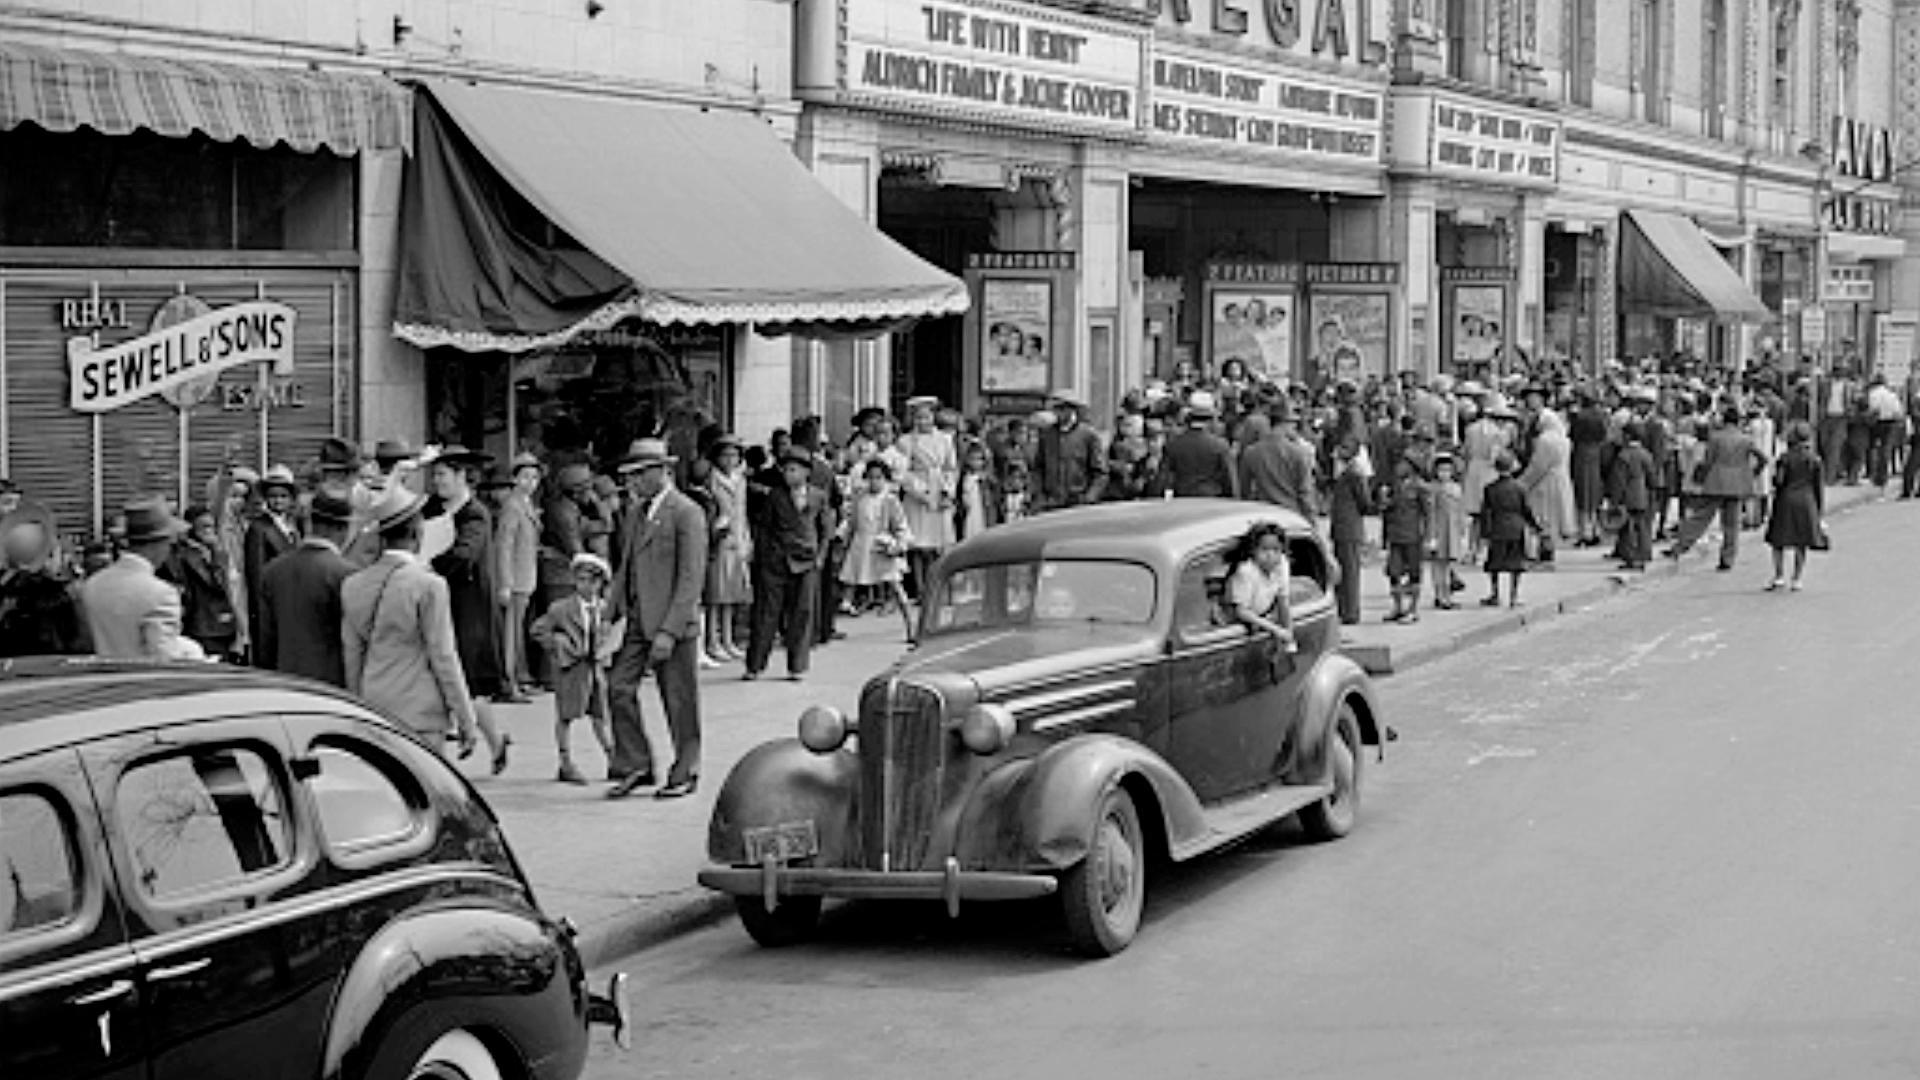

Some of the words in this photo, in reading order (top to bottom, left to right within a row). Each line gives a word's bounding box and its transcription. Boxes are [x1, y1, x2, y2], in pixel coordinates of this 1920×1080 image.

[970, 16, 1020, 54] WITH
[862, 50, 937, 94] ALDRICH
[941, 60, 1001, 101] FAMILY
[1003, 73, 1016, 105] &
[1018, 75, 1069, 111] JACKIE
[1071, 83, 1129, 119] COOPER
[61, 299, 131, 328] REAL
[82, 333, 195, 400] SEWELL
